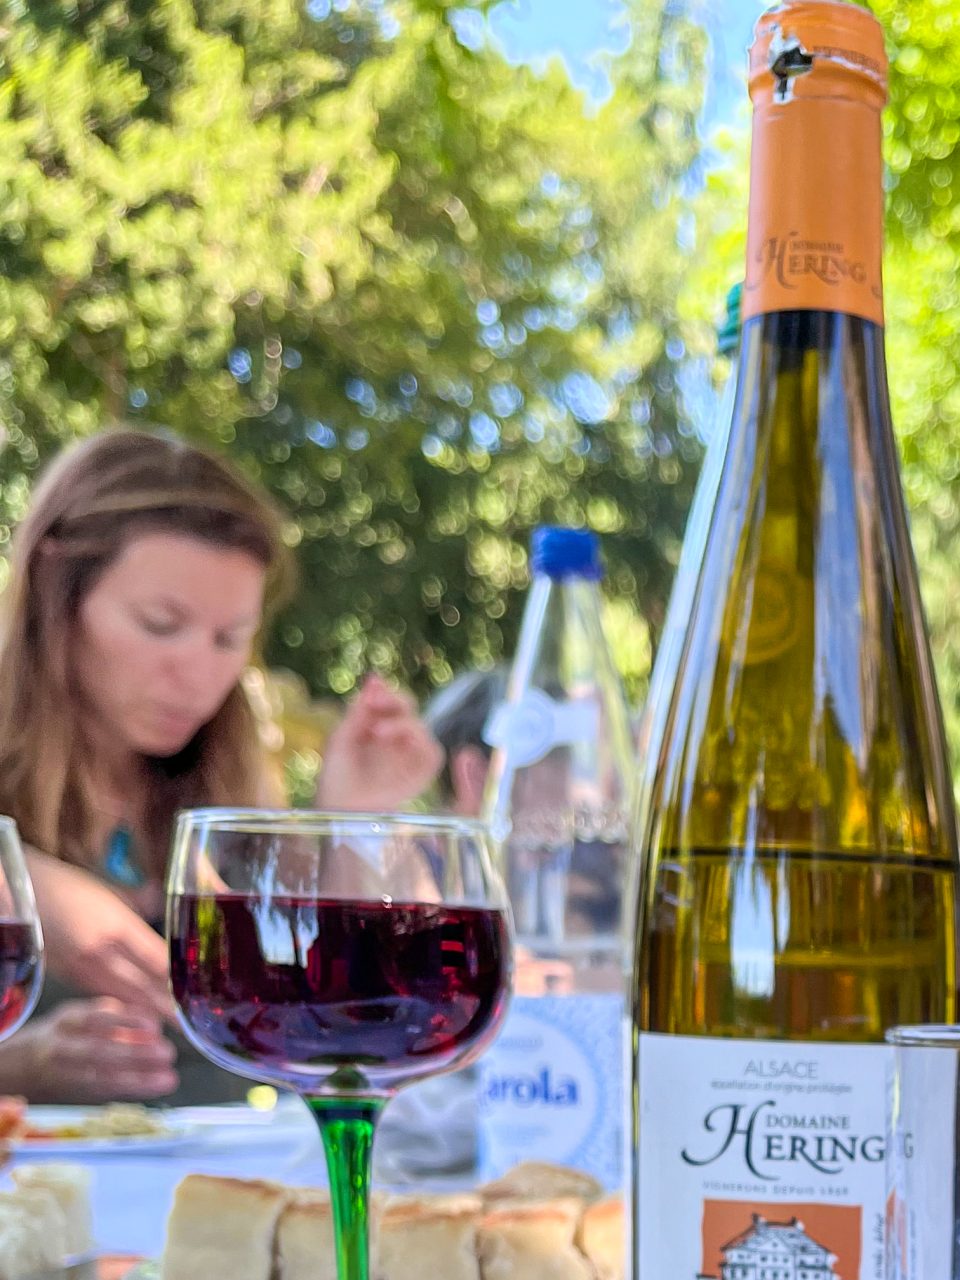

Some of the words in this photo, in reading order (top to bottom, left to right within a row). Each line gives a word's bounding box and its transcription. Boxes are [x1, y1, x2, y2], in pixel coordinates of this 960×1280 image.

[743, 1059, 819, 1079] ALSACE
[487, 1066, 579, 1104] arola
[765, 1113, 850, 1129] DOMAINE
[681, 1100, 886, 1180] HERING
